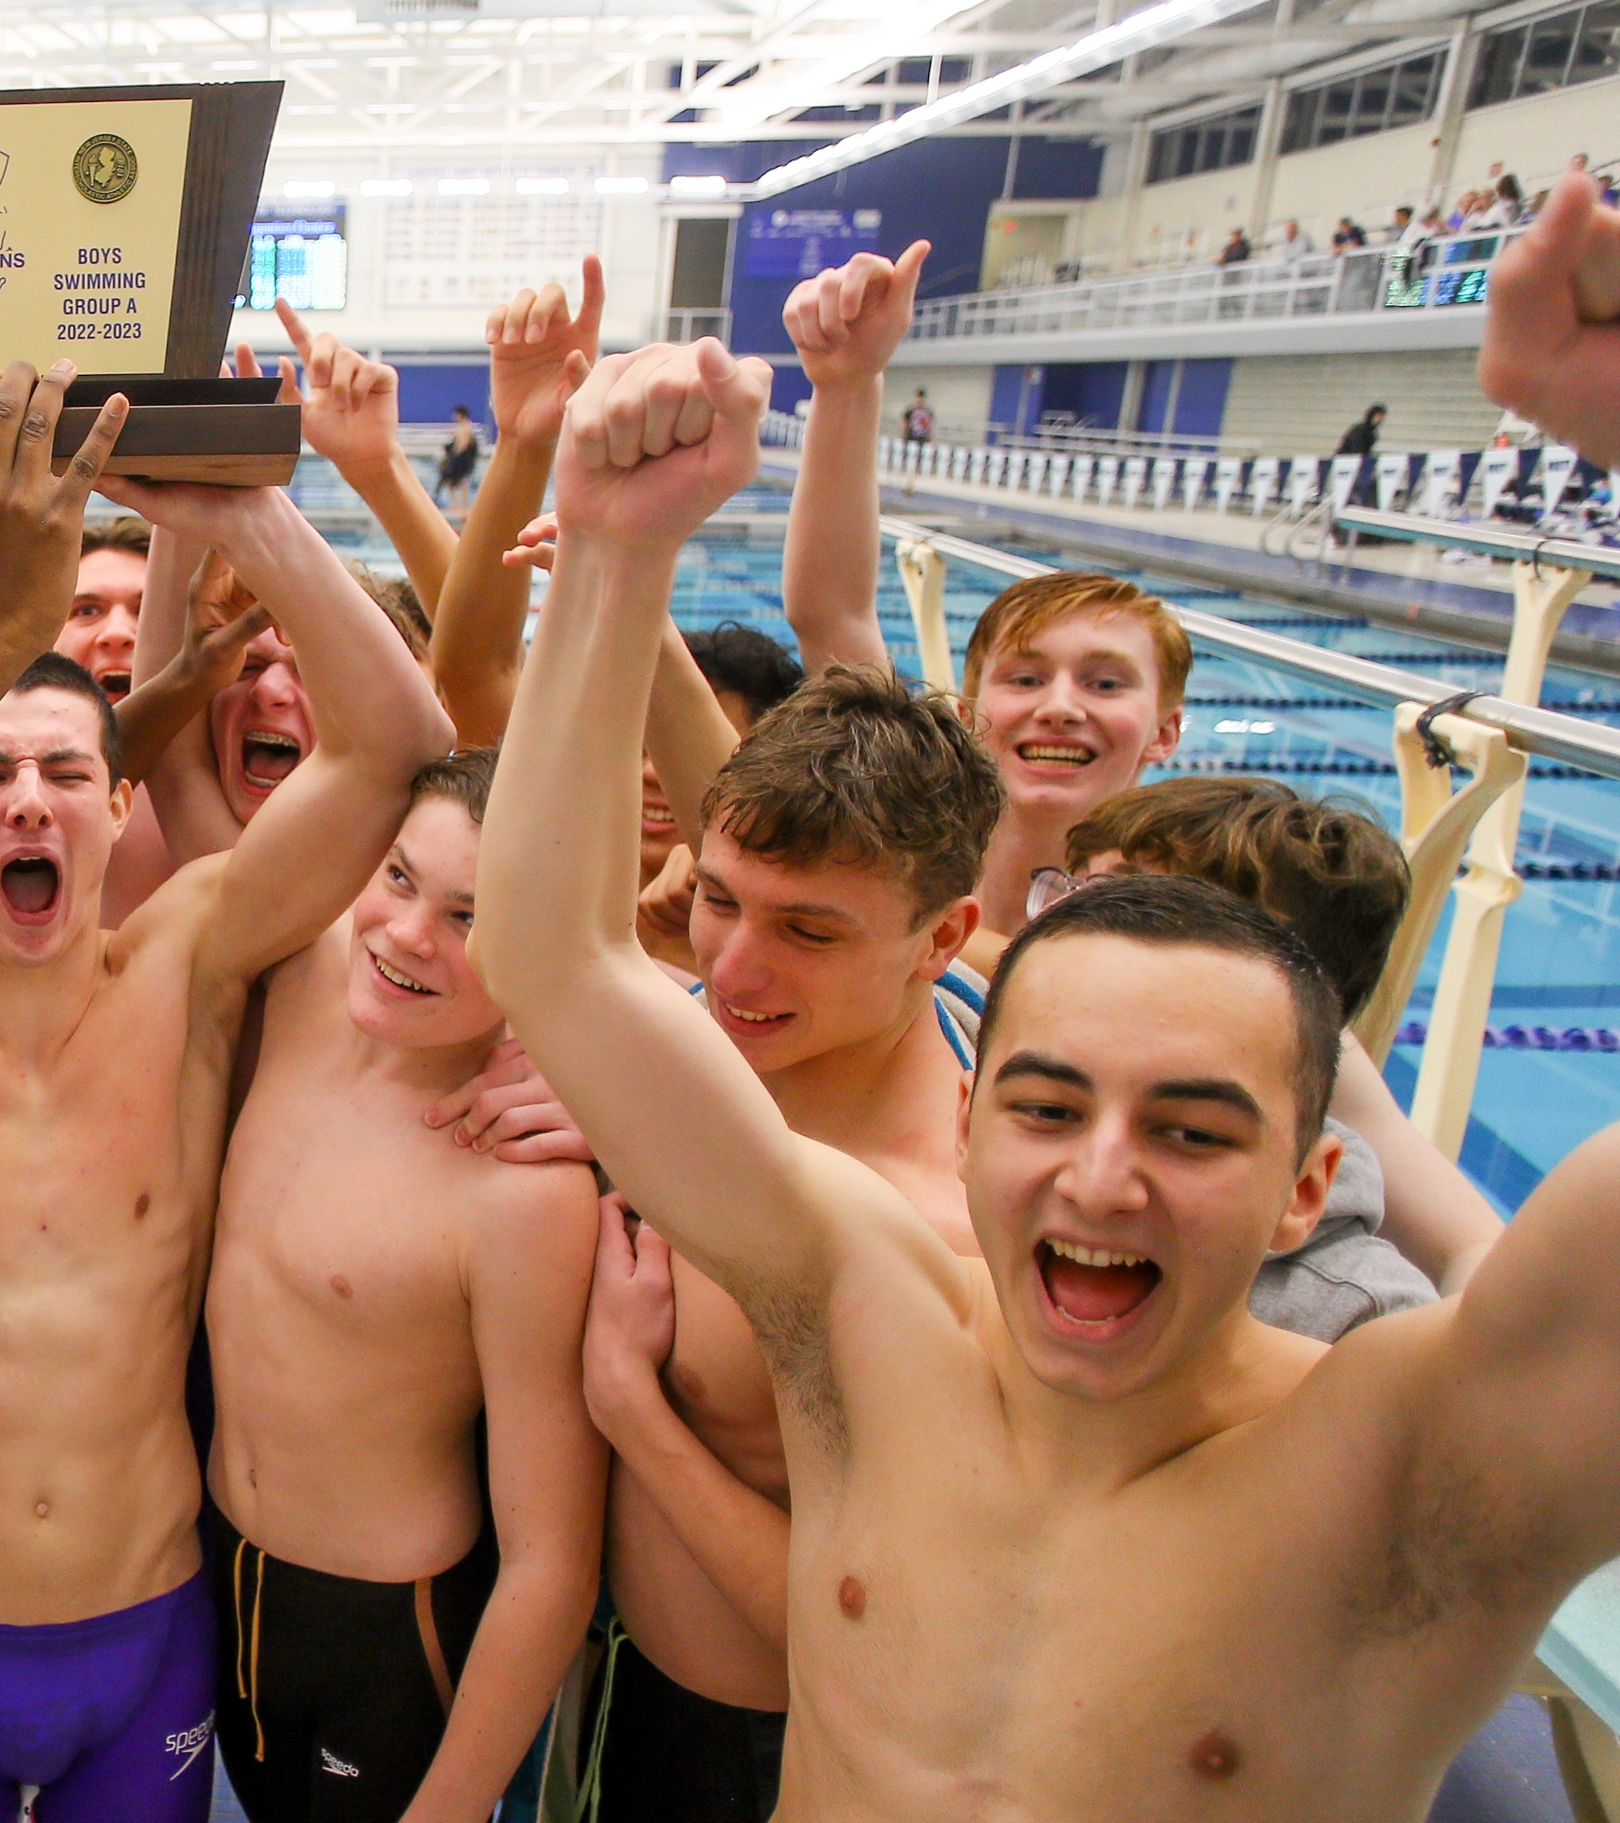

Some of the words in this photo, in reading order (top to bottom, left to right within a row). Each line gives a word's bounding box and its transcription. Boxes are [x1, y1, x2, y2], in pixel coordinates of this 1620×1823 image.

[78, 248, 122, 265] BOYS
[54, 272, 146, 290] SWIMMING
[63, 298, 121, 315] GROUP
[126, 298, 137, 314] A
[57, 322, 142, 340] 2022-2023
[165, 1709, 216, 1755] speed
[321, 1748, 359, 1777] speedo
